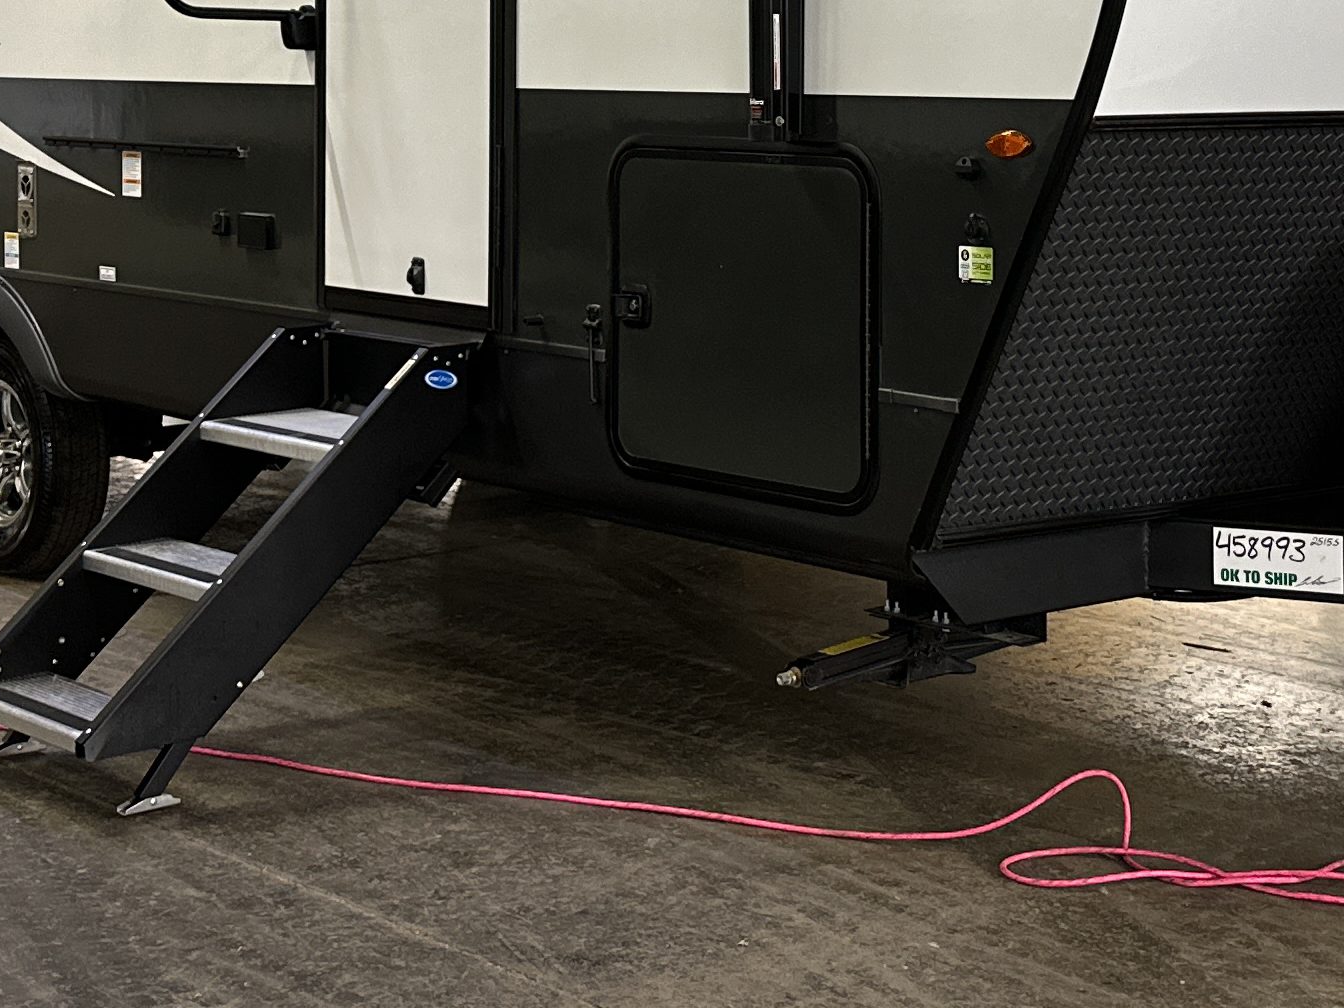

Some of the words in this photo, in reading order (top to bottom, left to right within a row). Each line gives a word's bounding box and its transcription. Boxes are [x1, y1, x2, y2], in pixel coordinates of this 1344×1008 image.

[1215, 530, 1306, 563] 458993
[1220, 568, 1240, 582] OK
[1243, 570, 1261, 584] TO
[1264, 571, 1298, 586] SHIP
